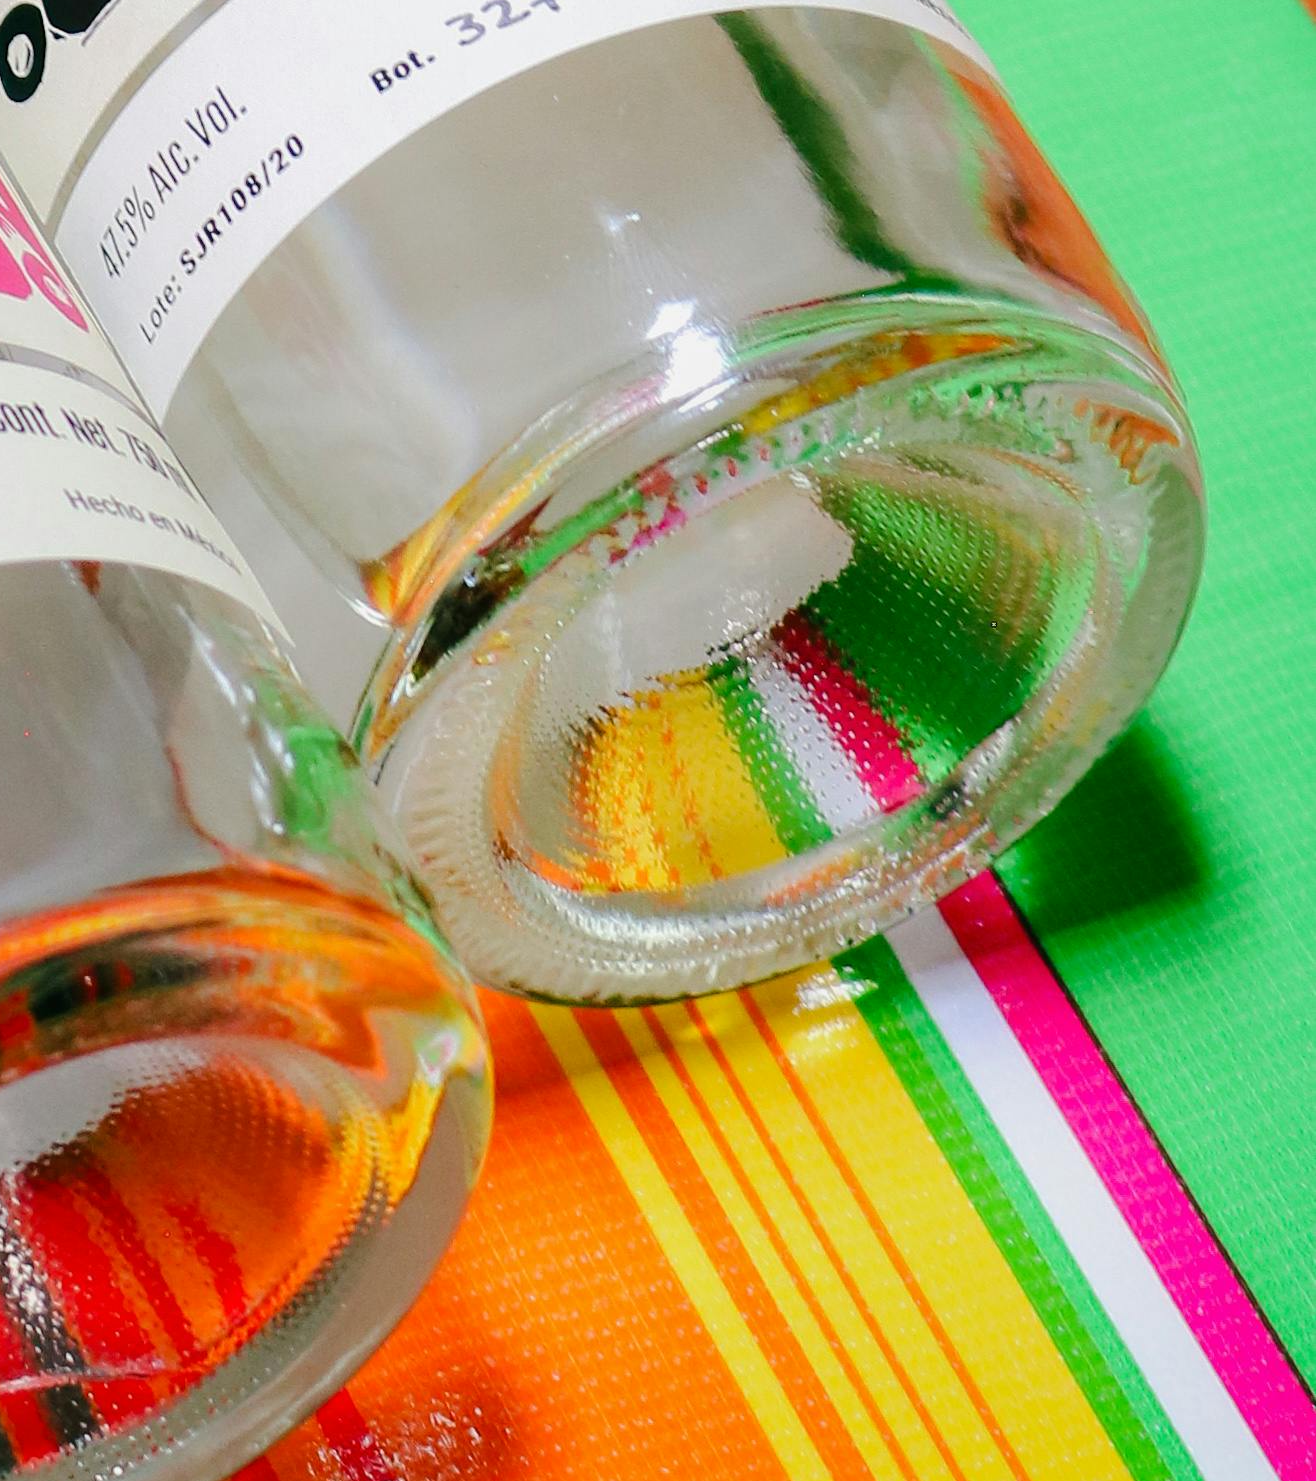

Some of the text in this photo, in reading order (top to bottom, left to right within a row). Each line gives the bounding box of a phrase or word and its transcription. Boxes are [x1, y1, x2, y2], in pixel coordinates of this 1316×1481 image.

[368, 49, 436, 93] Bot.
[99, 84, 248, 279] 47.5% Alc. Vol.
[138, 133, 305, 346] Lote: SJR108/20
[60, 407, 126, 457] Net.
[62, 488, 145, 524] Hecho
[149, 510, 177, 533] en
